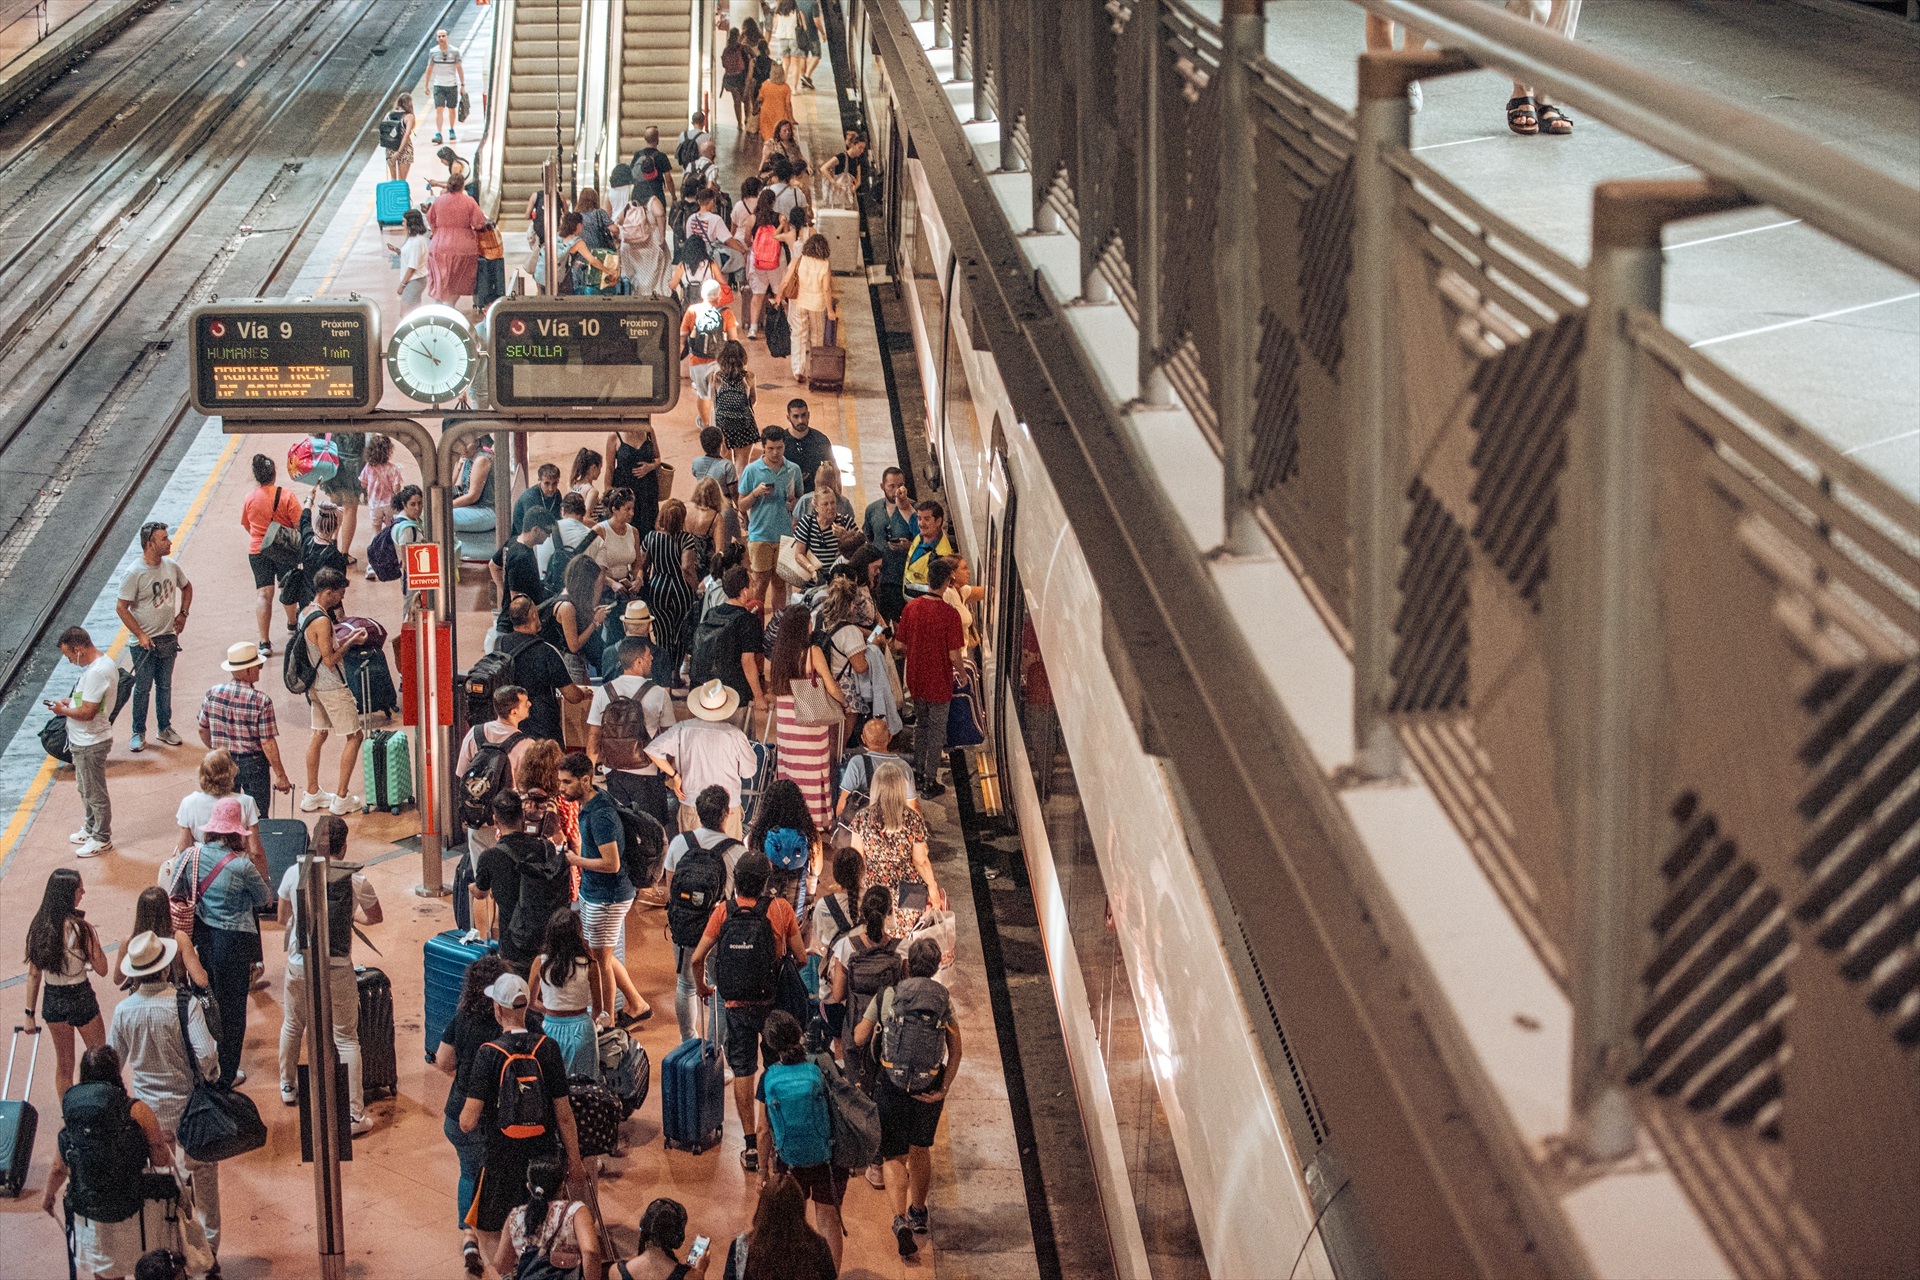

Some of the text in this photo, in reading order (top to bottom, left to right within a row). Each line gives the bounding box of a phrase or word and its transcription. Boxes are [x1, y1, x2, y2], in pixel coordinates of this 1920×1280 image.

[236, 321, 293, 339] Vía 9
[331, 329, 350, 337] tren
[536, 318, 600, 337] Vía 10
[629, 328, 649, 336] tren
[207, 346, 350, 360] HUMANES 1 min
[506, 345, 562, 358] SEVILLA
